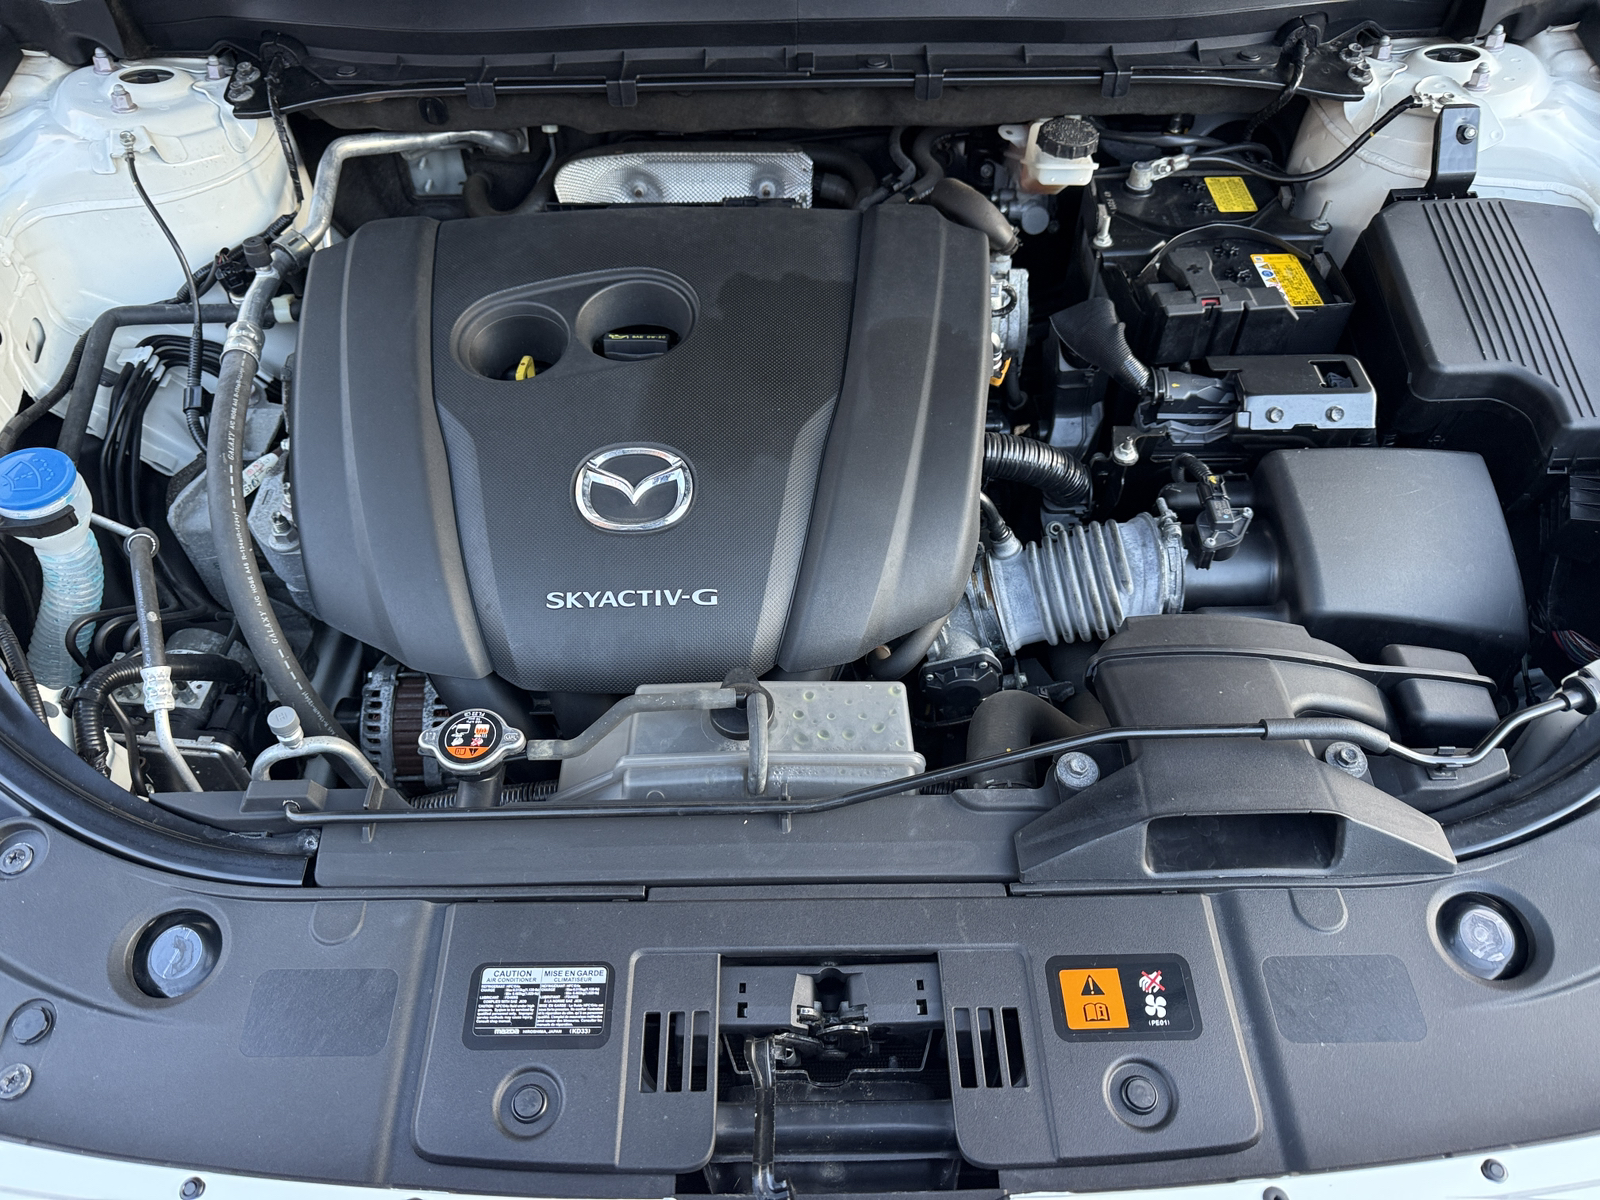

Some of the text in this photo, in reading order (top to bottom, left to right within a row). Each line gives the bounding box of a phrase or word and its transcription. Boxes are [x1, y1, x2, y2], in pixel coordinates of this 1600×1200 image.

[227, 430, 236, 460] GALAXY
[247, 576, 257, 594] HOSE
[546, 588, 718, 609] SKYACTIV-G
[259, 610, 279, 644] GALAXY
